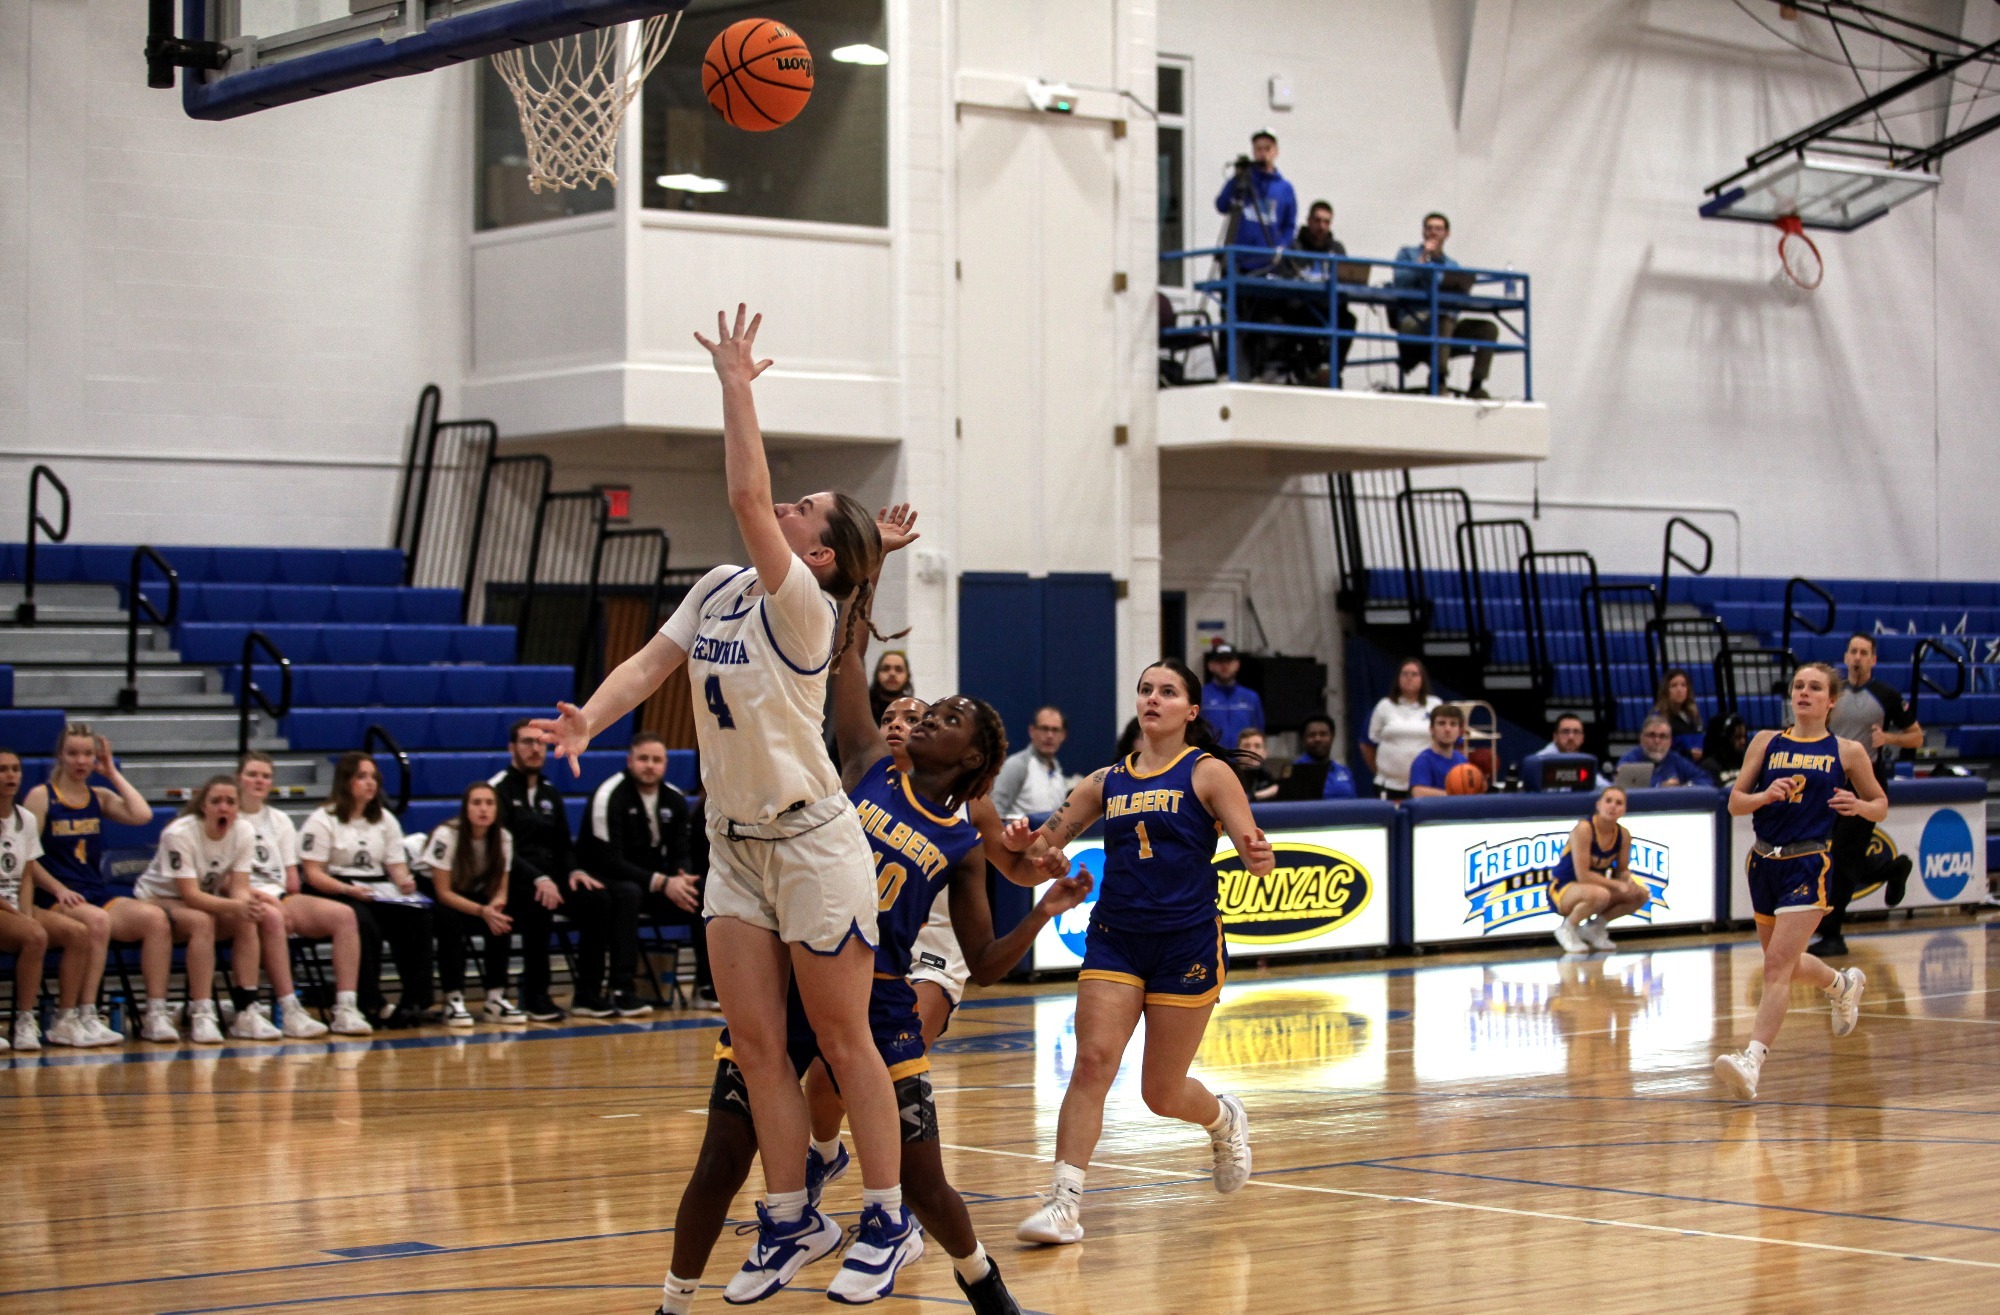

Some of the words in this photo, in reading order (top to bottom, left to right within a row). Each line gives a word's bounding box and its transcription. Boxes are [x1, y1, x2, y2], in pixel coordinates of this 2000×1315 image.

[705, 673, 737, 731] 4
[1768, 751, 1836, 774] HILBERT
[1105, 789, 1185, 821] HILBERT
[855, 799, 949, 882] HILBERT
[1134, 821, 1154, 860] 1
[1469, 840, 1566, 884] FREDON
[1924, 852, 1973, 879] NCAA
